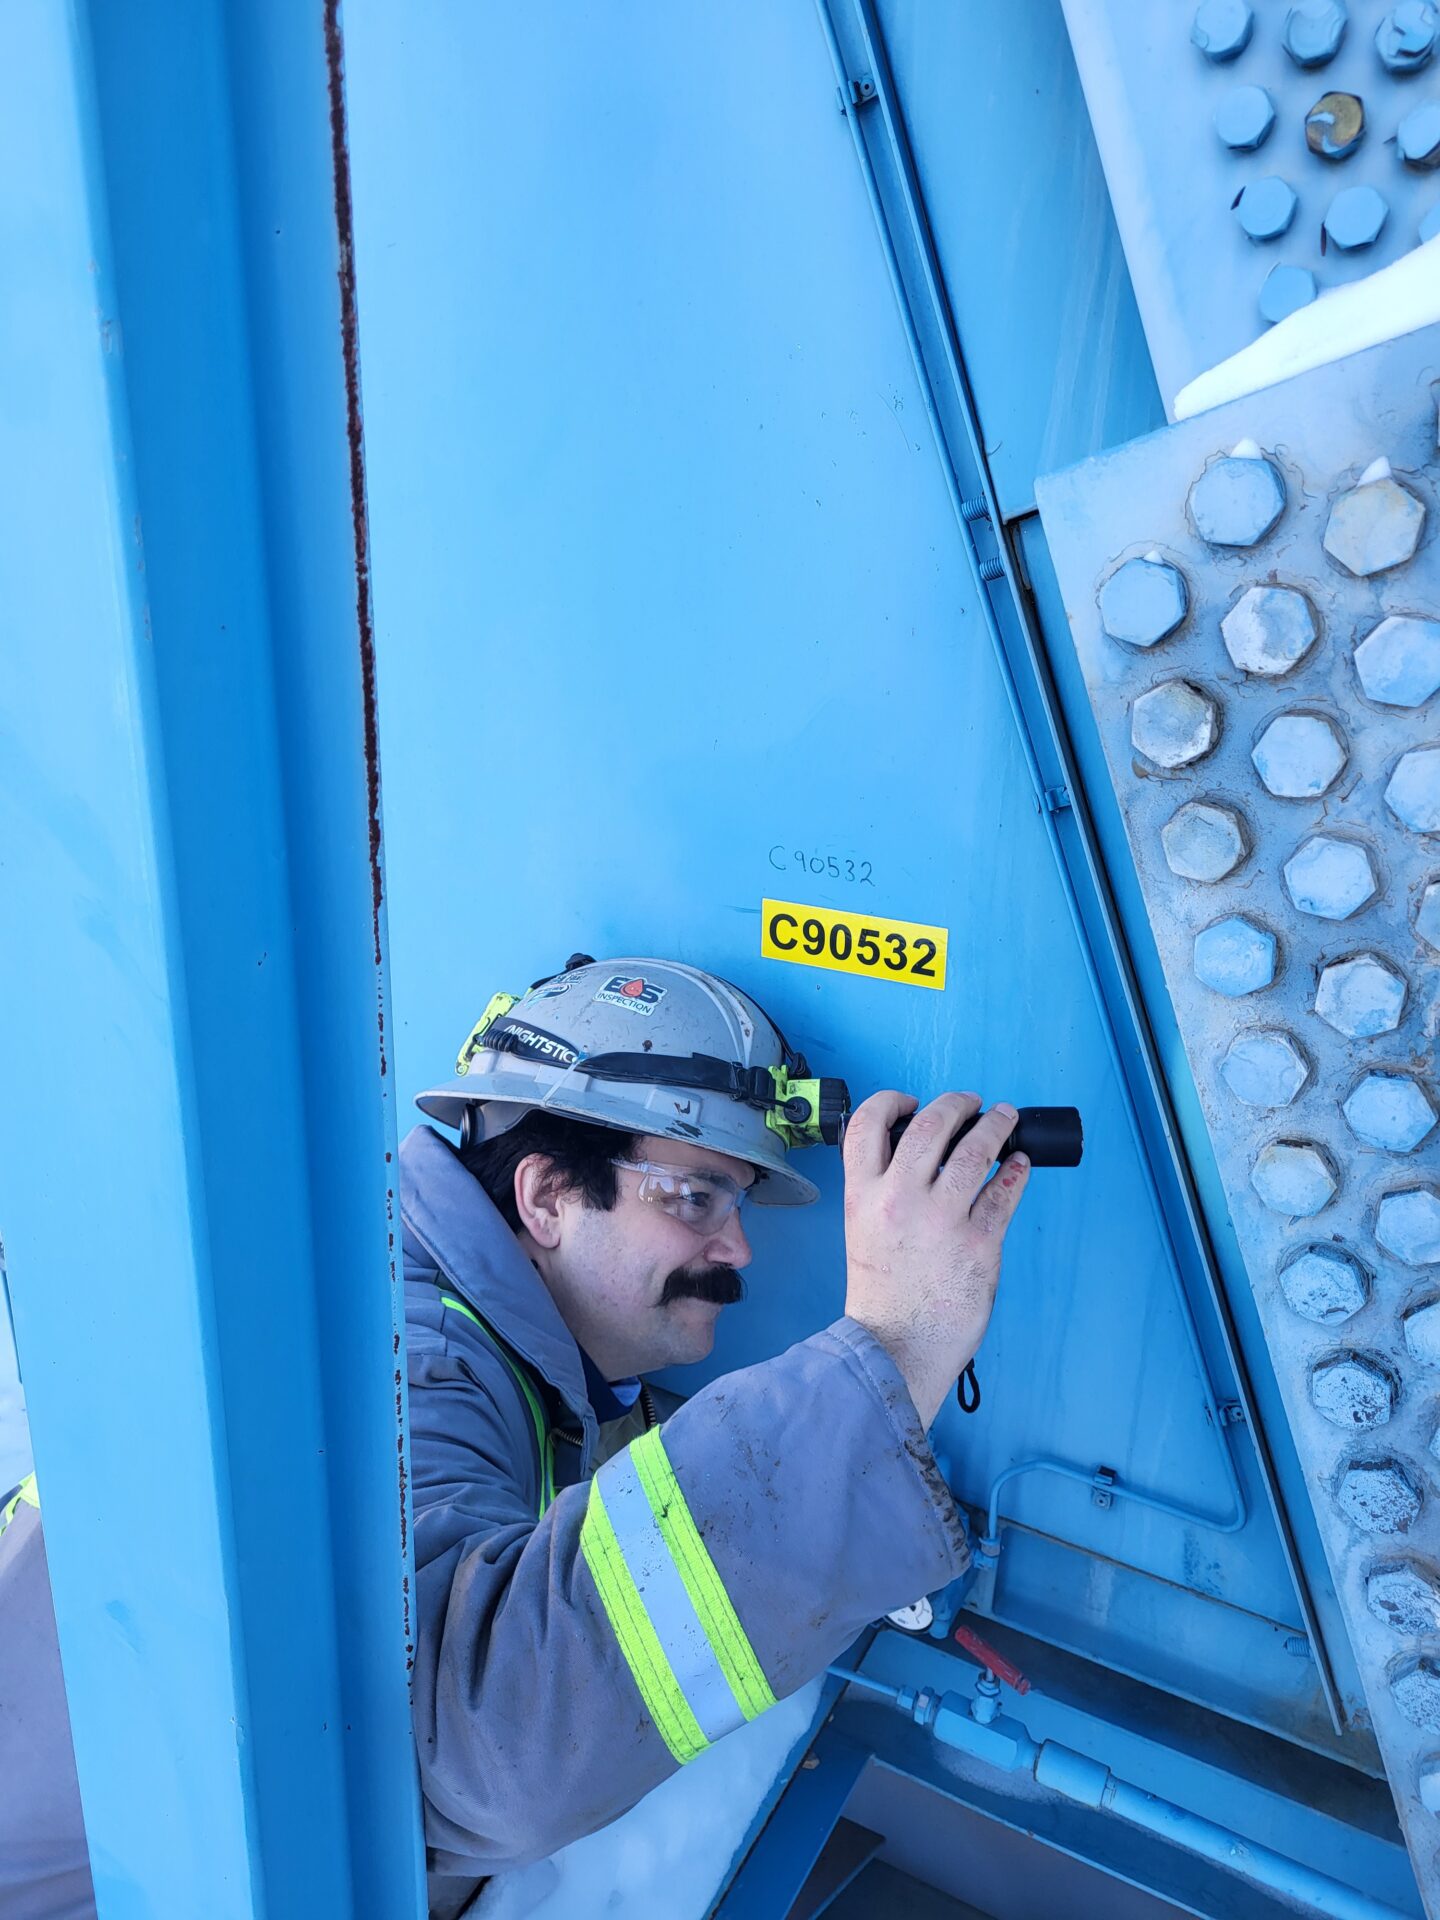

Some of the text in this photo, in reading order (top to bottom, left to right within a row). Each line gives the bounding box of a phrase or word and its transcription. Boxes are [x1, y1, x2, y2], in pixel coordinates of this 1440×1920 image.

[769, 913, 937, 977] C90532
[597, 993, 651, 1013] INSPECTION
[504, 1024, 577, 1063] NIGHTSTIC
